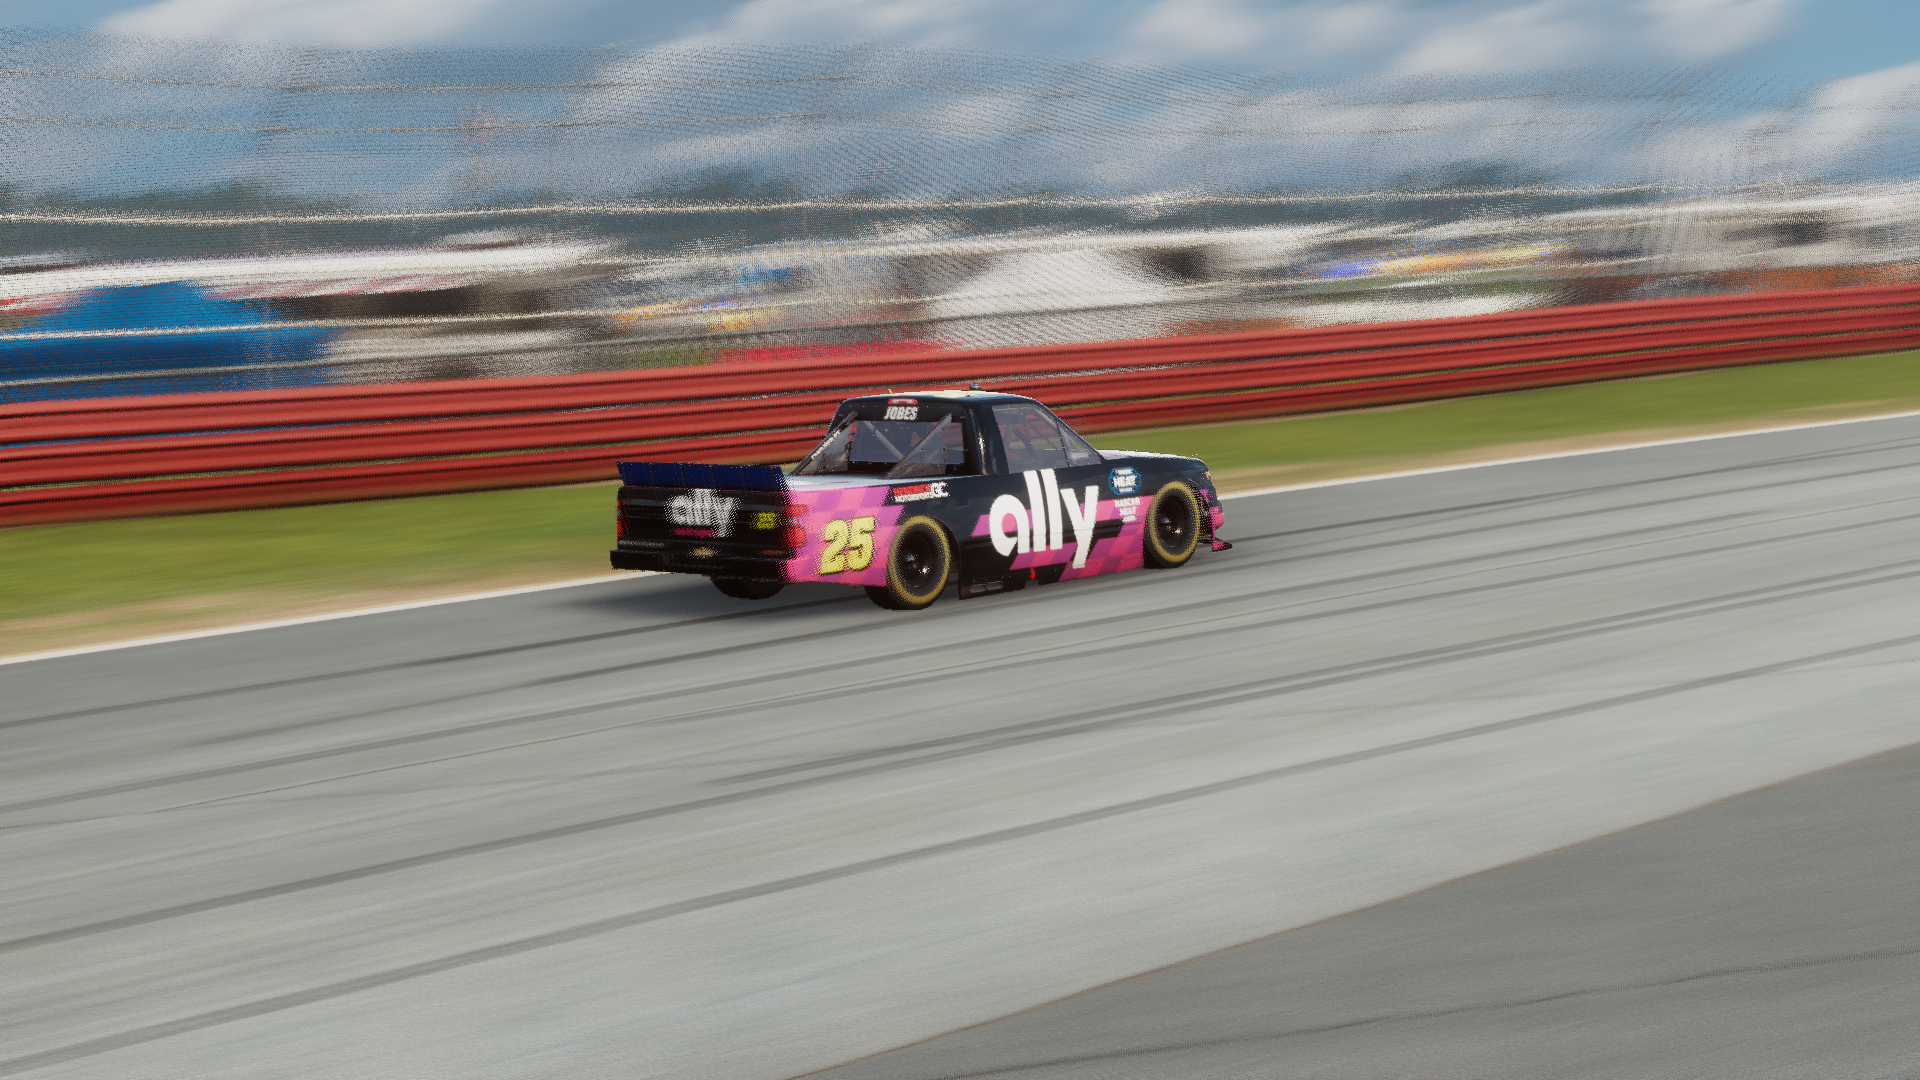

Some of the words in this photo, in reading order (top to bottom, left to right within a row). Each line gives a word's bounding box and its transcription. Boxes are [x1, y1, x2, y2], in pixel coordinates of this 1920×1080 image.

[884, 406, 919, 420] JOBES
[665, 488, 738, 538] ally
[988, 468, 1099, 570] ally
[815, 516, 876, 576] 25
